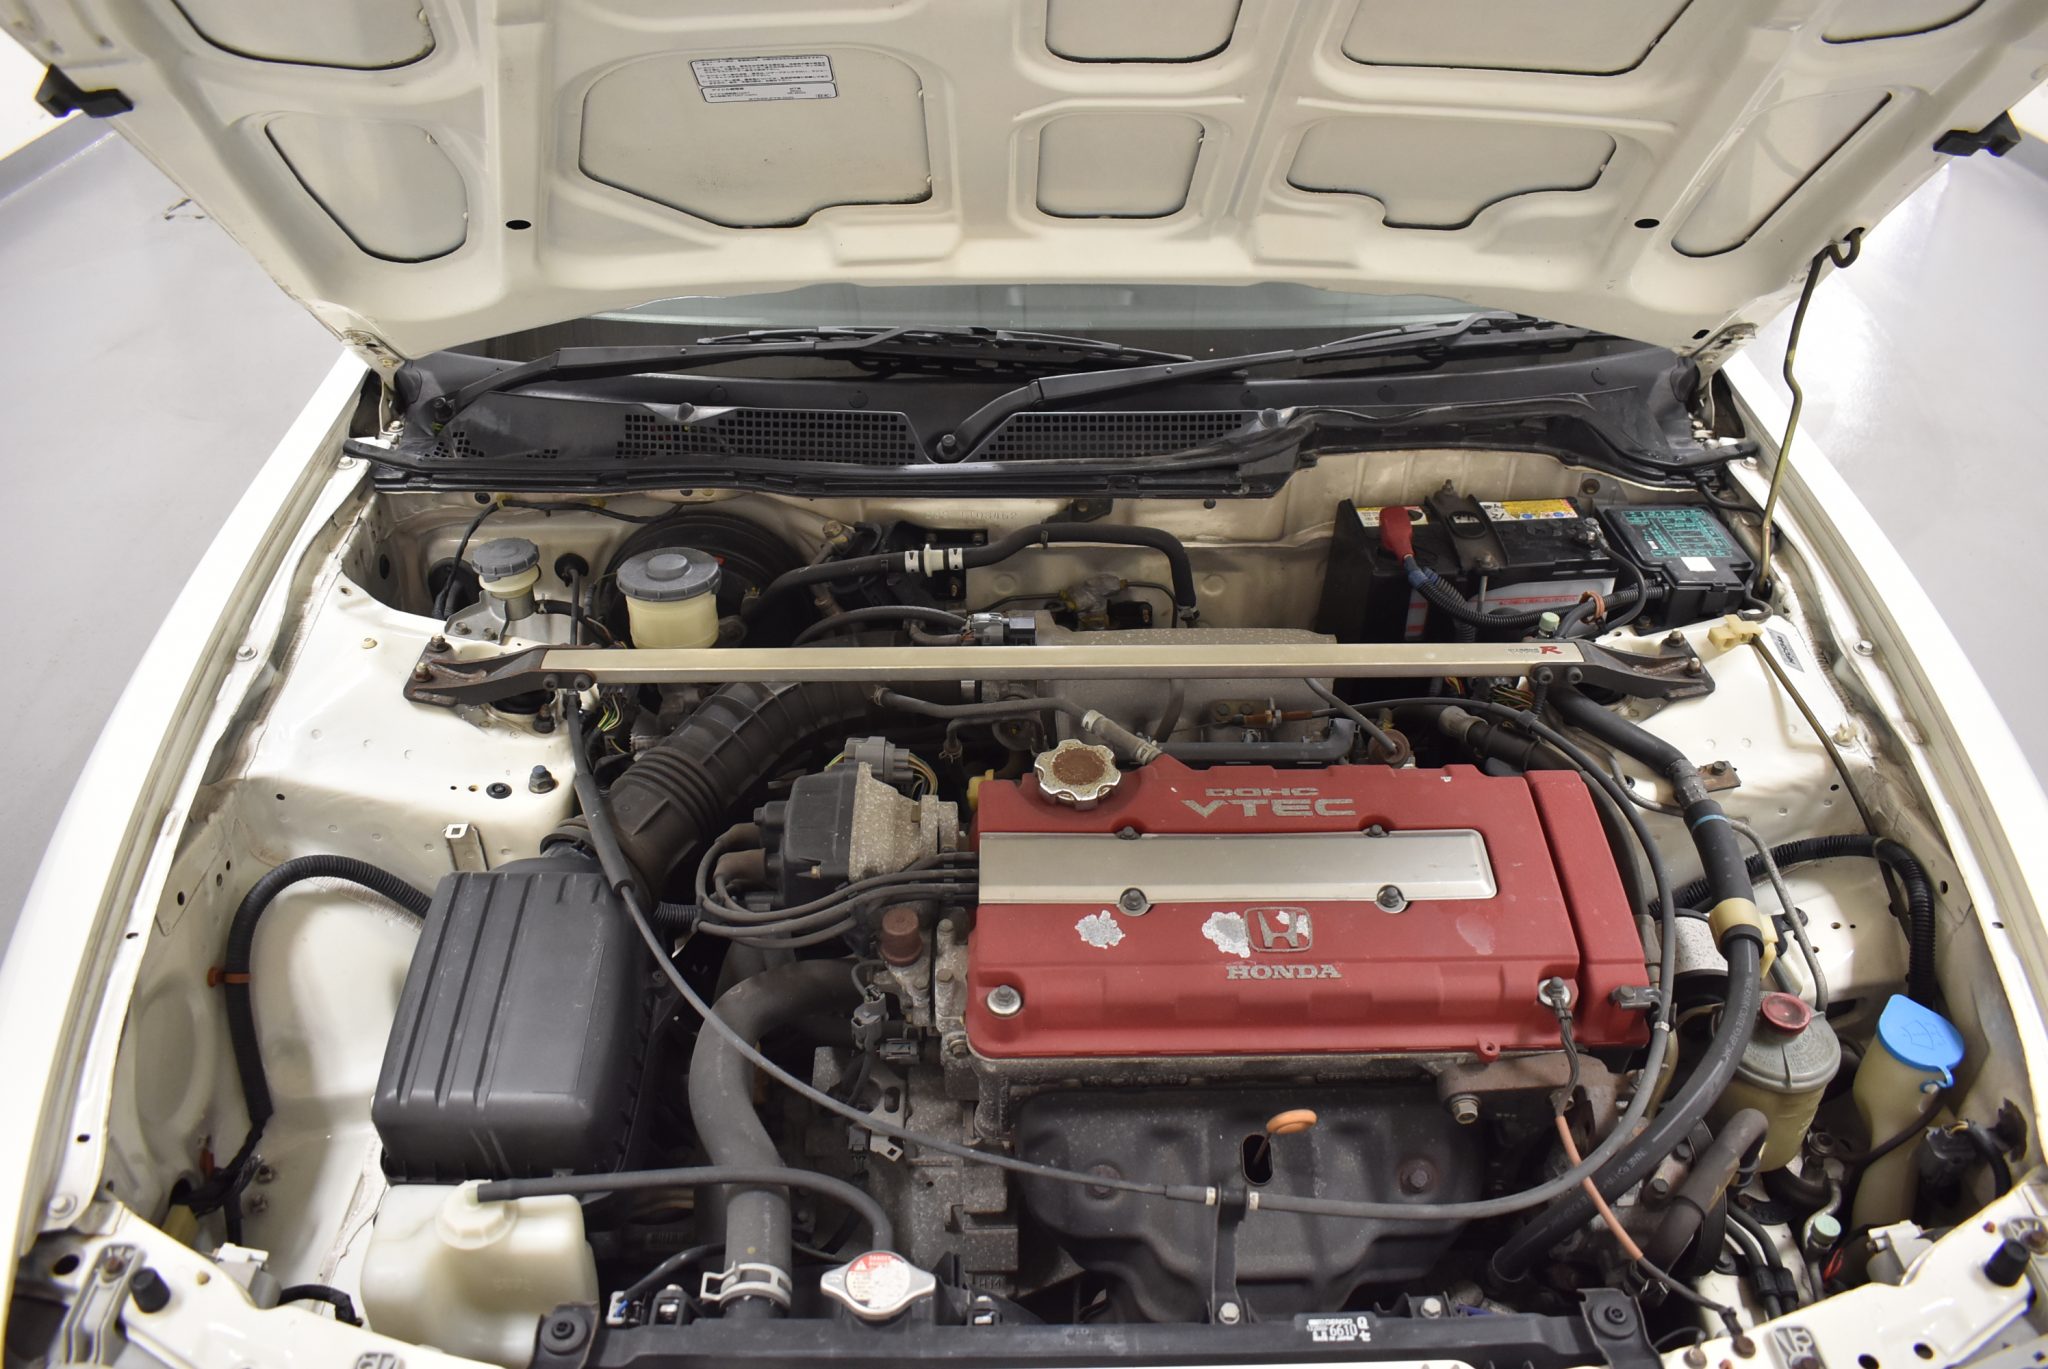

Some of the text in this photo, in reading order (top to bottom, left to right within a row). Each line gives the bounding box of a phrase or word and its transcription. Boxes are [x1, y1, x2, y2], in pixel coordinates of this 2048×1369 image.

[1205, 787, 1318, 797] DOHC
[1182, 799, 1356, 818] VTEC
[1226, 964, 1342, 980] HONDA
[1329, 1323, 1358, 1337] 6610
